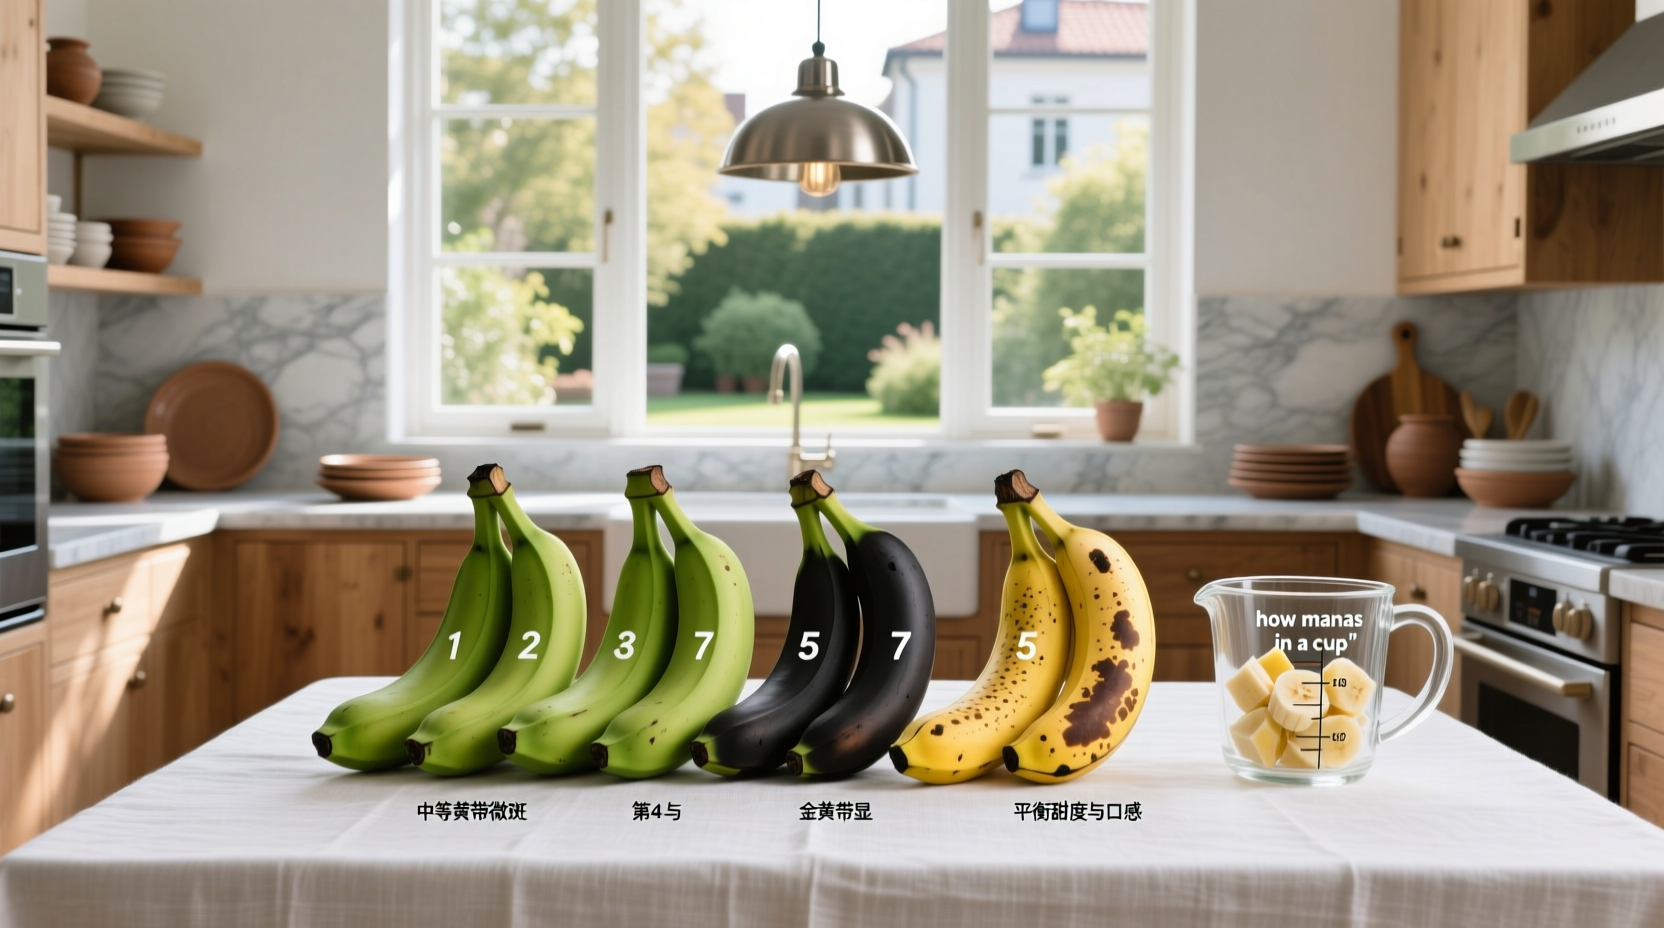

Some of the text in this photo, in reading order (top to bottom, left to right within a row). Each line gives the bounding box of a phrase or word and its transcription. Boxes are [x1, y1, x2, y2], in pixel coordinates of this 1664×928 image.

[1256, 610, 1363, 627] how manas
[1275, 633, 1292, 651] in
[1297, 639, 1308, 651] a
